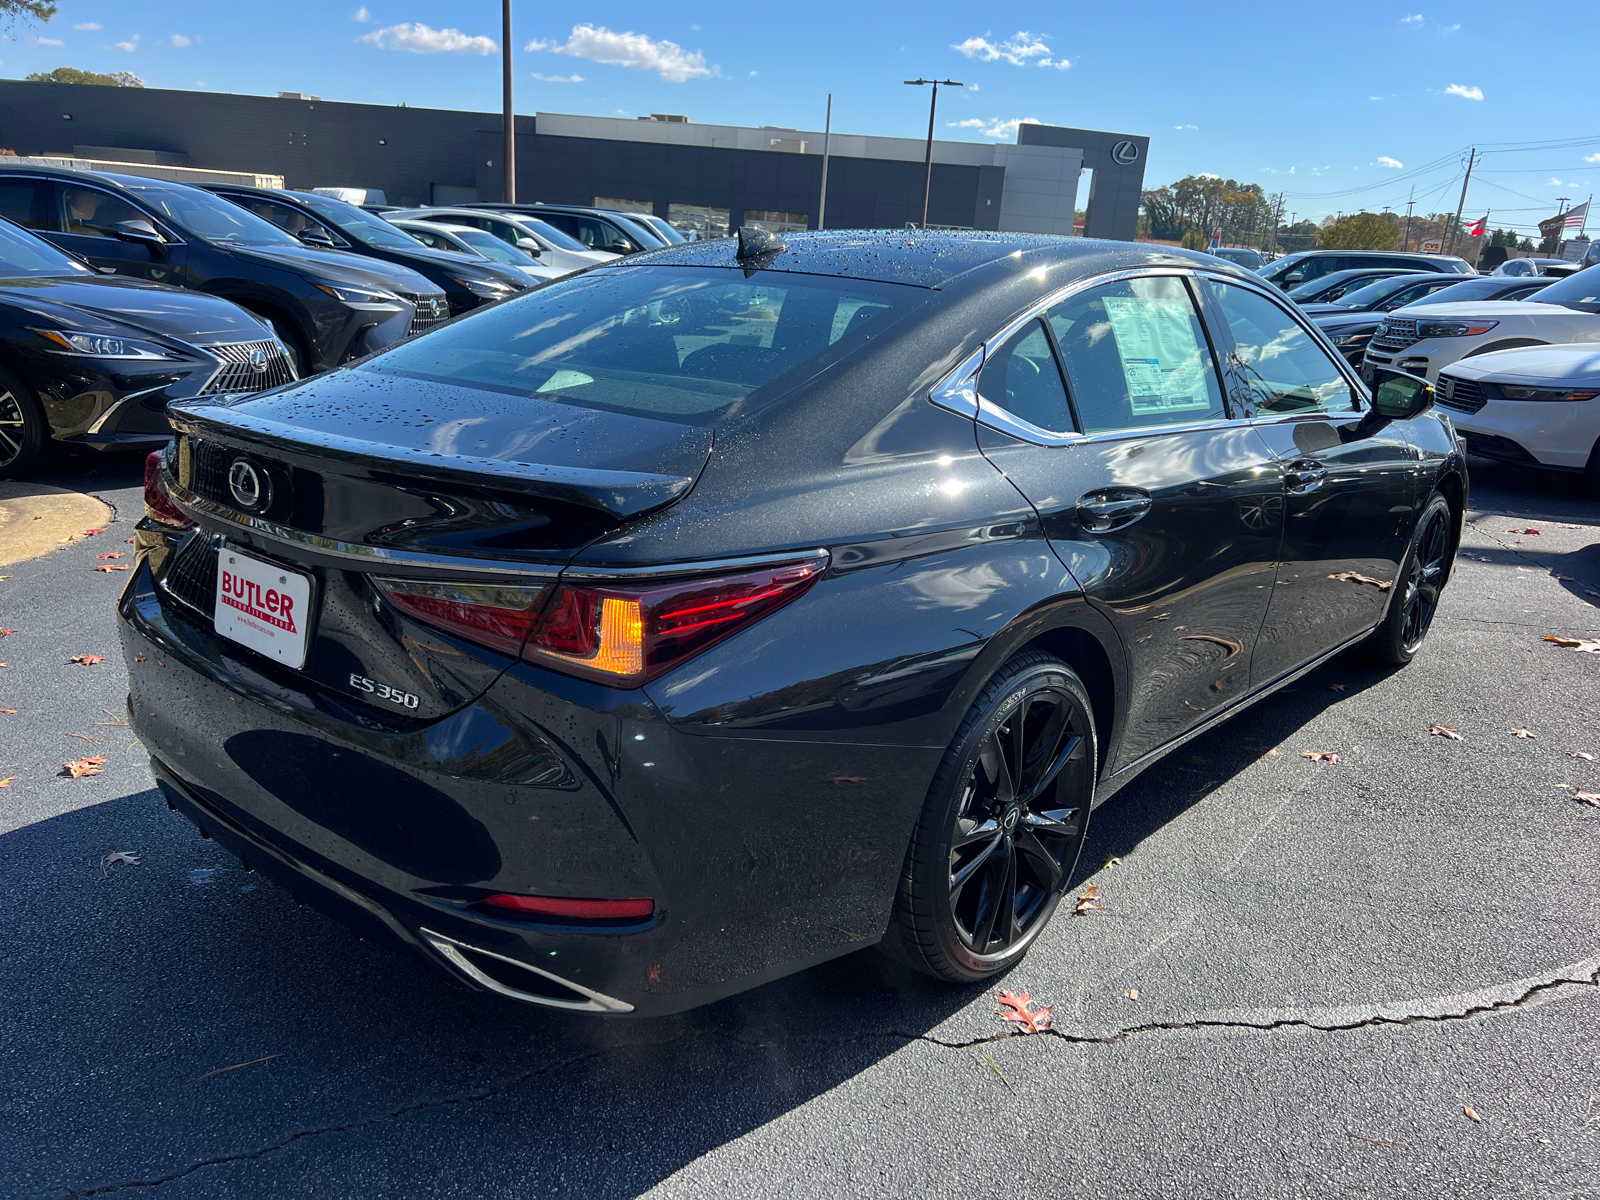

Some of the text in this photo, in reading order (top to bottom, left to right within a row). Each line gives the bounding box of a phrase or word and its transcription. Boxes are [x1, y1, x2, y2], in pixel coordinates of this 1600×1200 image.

[269, 617, 294, 632] GROUP
[350, 673, 419, 708] ES 350
